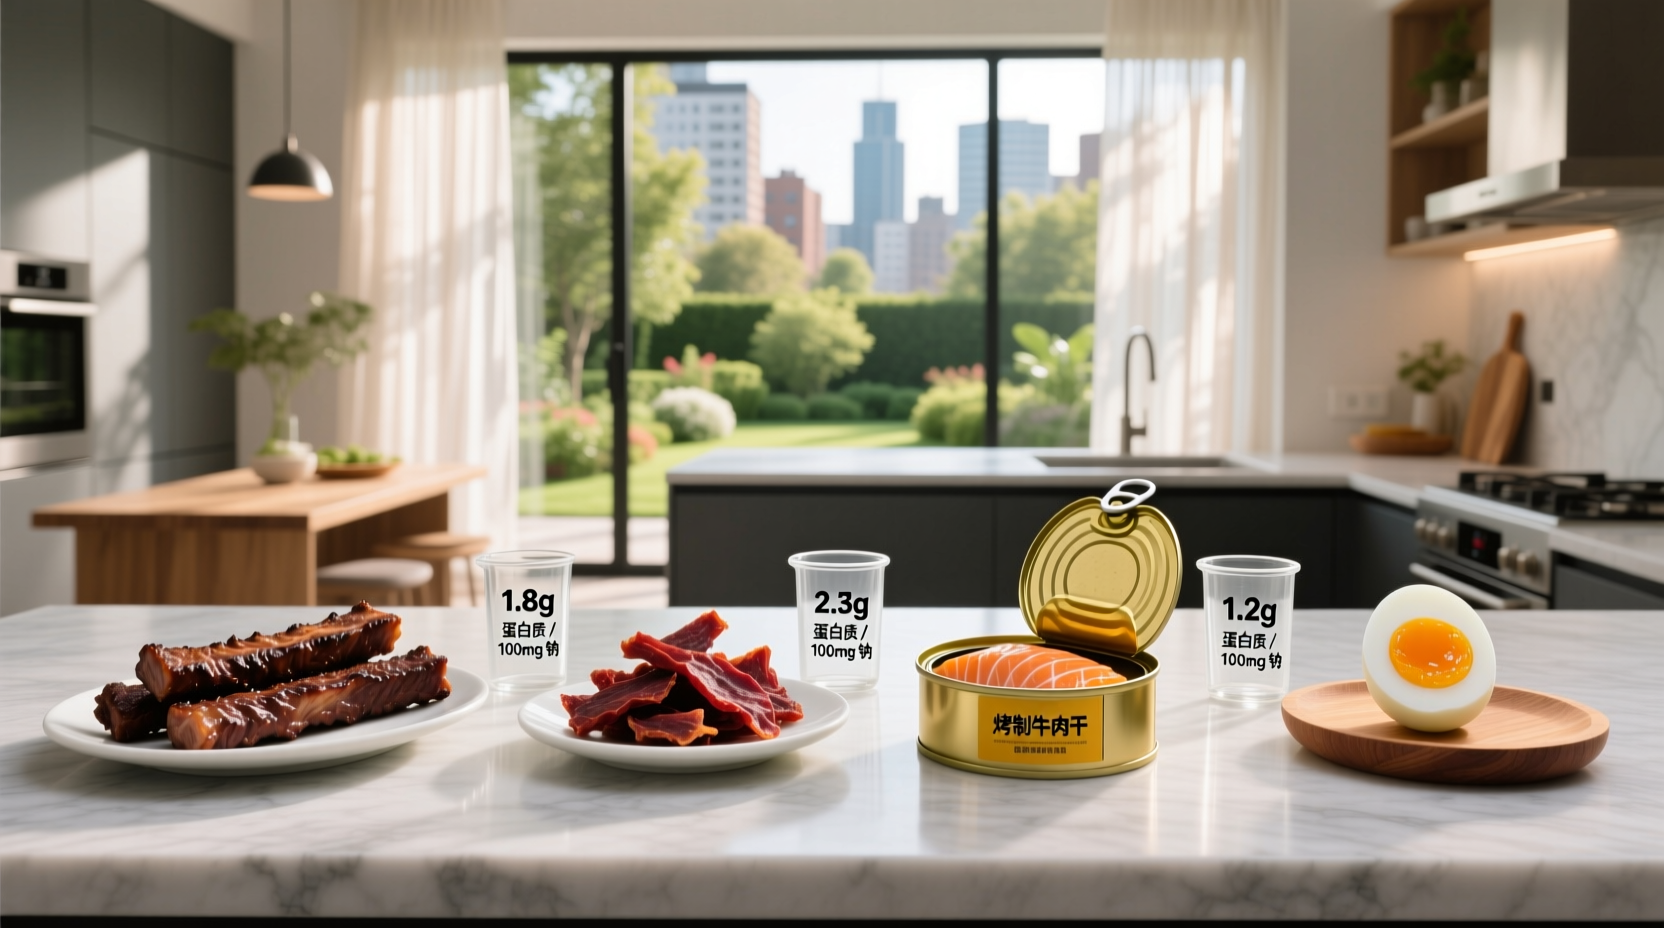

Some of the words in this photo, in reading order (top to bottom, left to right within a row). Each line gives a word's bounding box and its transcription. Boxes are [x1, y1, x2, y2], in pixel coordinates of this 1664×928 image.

[502, 589, 555, 618] 1.8g
[814, 590, 869, 621] 2.3g
[1223, 596, 1277, 628] 1.2g
[993, 713, 1088, 737] 烤制牛肉干
